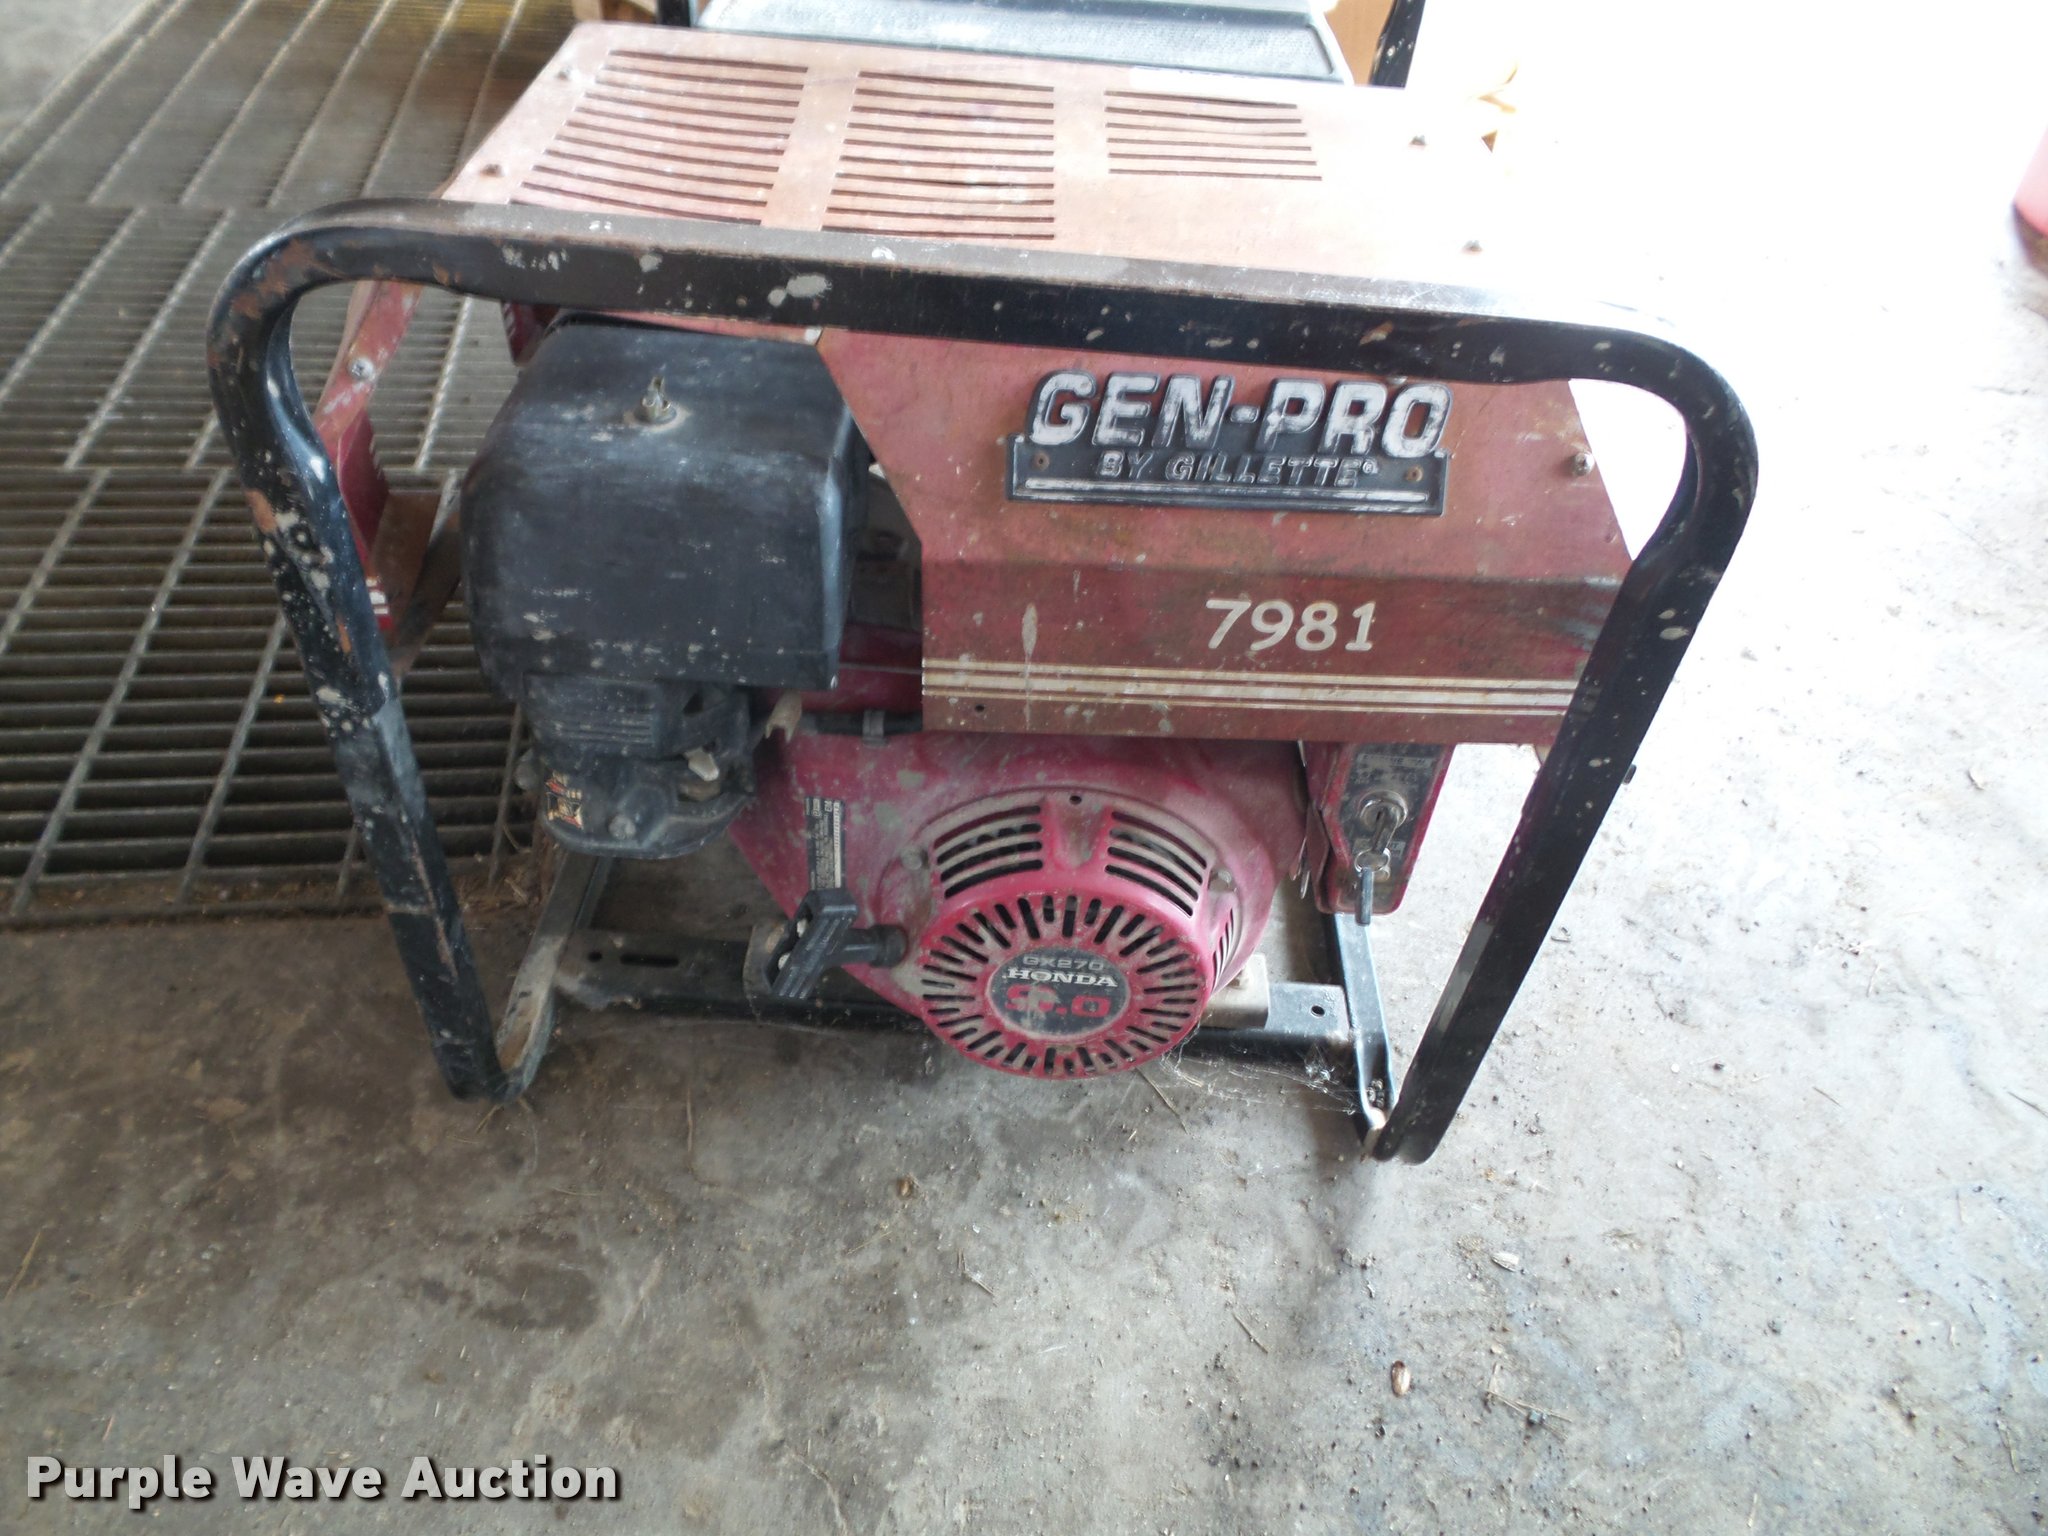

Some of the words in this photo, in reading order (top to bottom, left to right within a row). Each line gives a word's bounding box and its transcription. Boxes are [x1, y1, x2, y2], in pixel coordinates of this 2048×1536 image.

[1029, 371, 1452, 458] GEN-PRO
[1097, 450, 1153, 480] BY
[1205, 600, 1376, 651] 7981
[1006, 967, 1118, 988] HONDA
[1022, 955, 1104, 971] GX270
